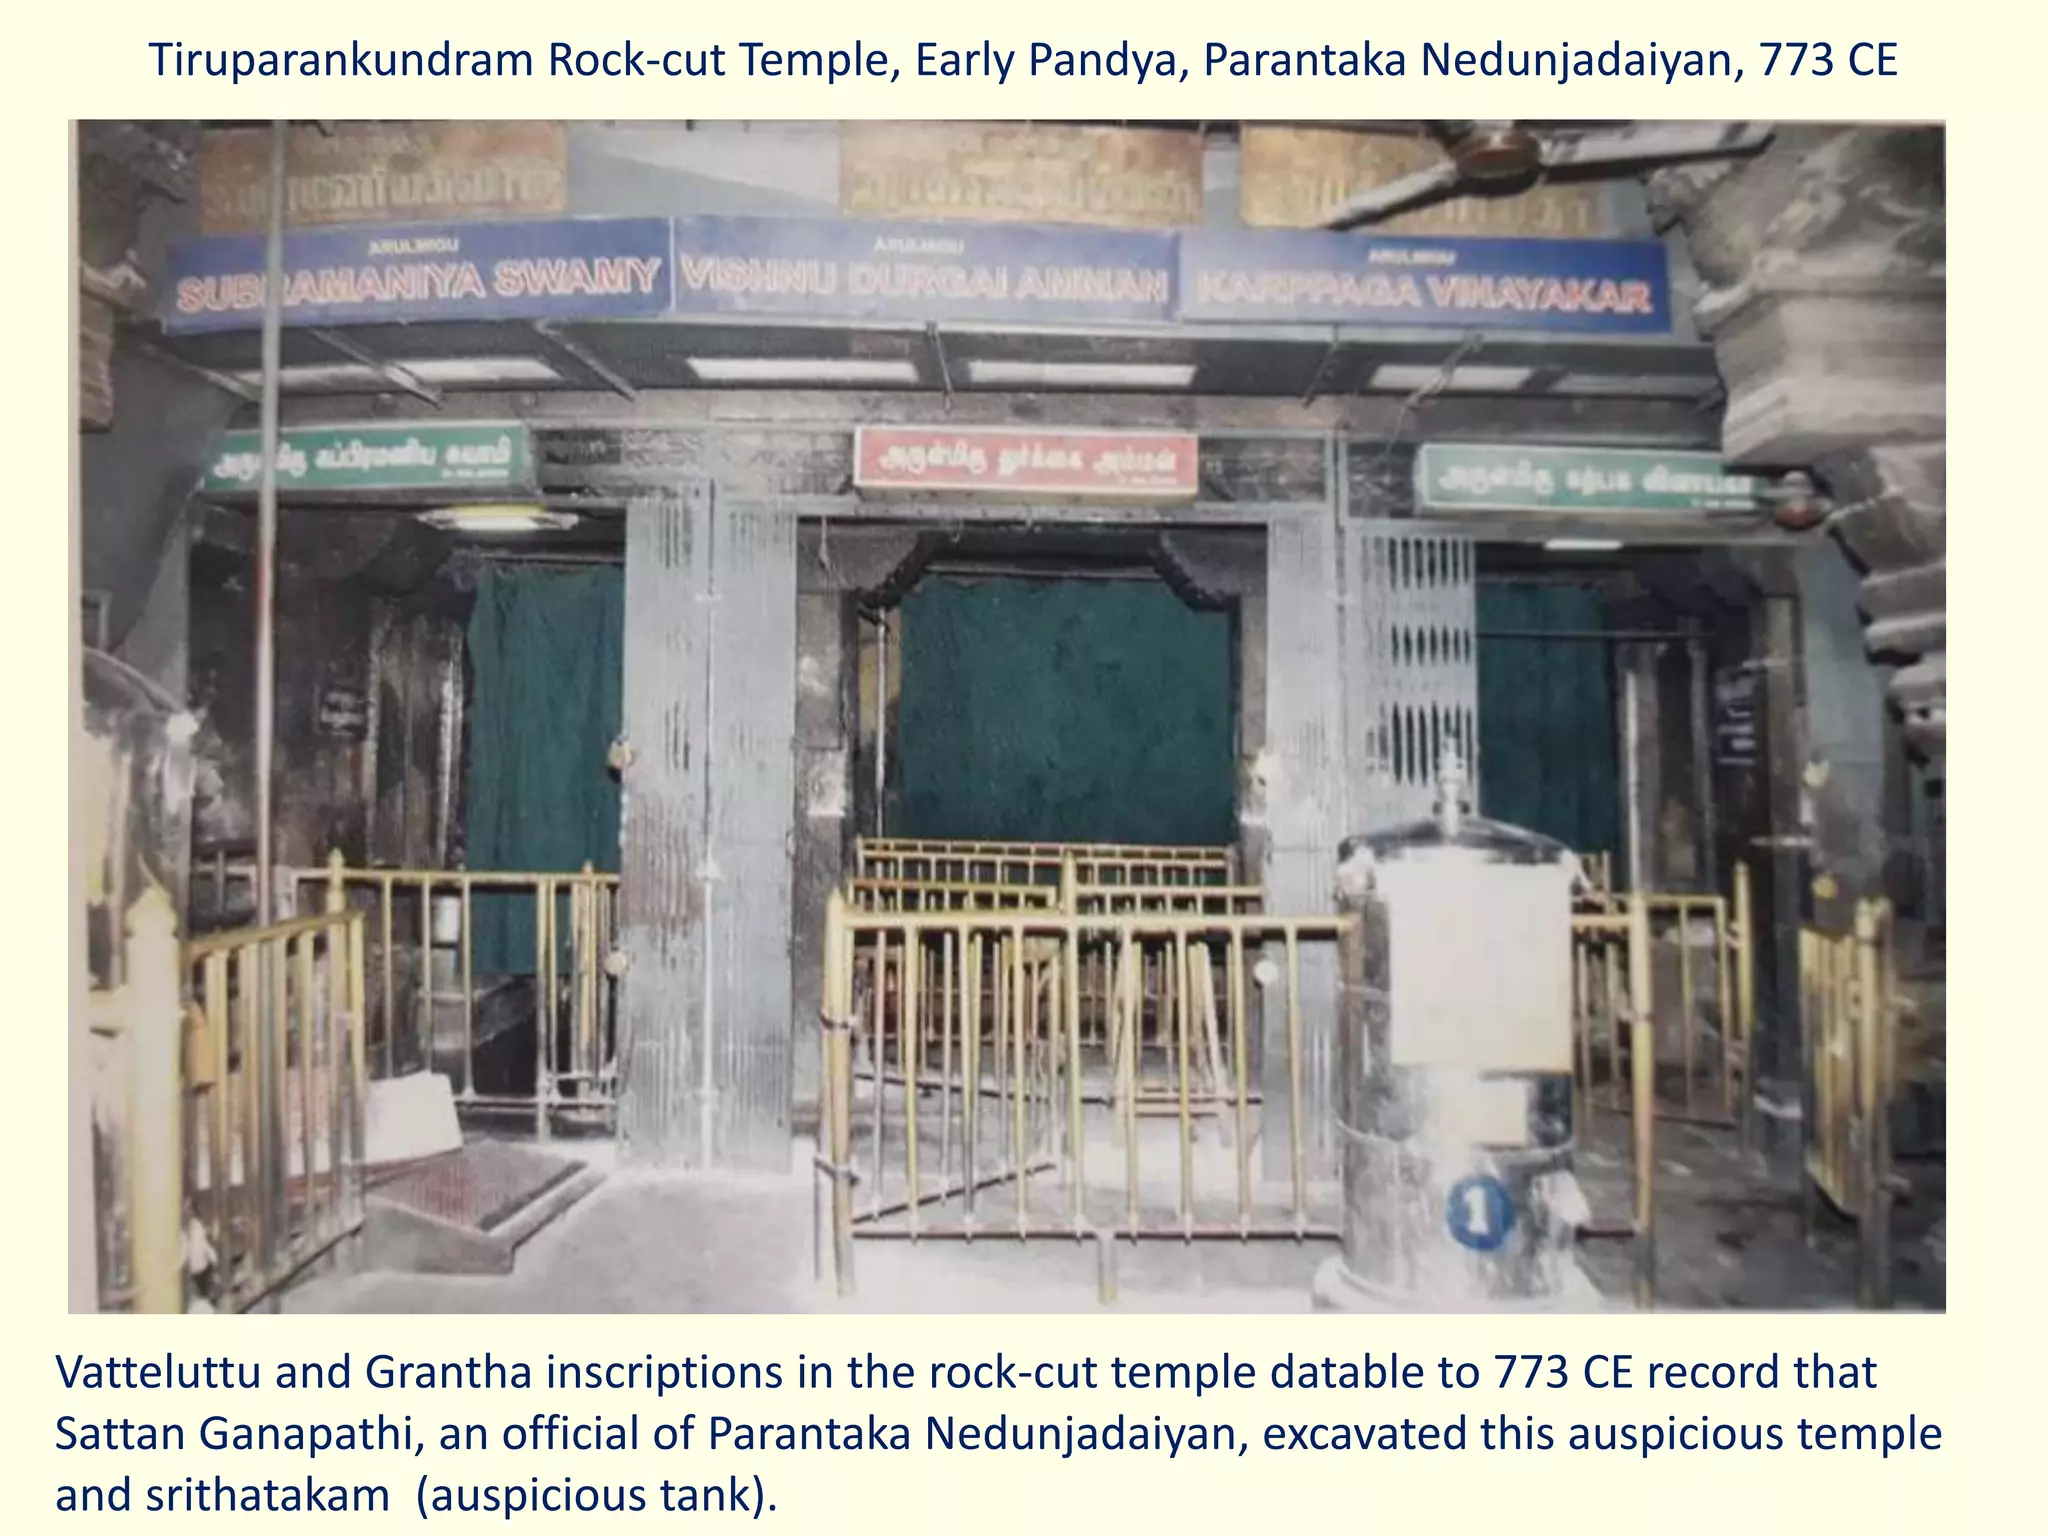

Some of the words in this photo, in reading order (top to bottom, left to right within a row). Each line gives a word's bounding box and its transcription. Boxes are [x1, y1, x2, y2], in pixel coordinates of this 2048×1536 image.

[179, 263, 485, 312] SUBAMANIYA
[494, 256, 663, 297] SWAMY
[680, 255, 836, 294] VISHNU
[1198, 271, 1419, 307] KARPPAGA
[1426, 273, 1653, 314] VINAYAKAR
[1465, 1187, 1488, 1233] 1
